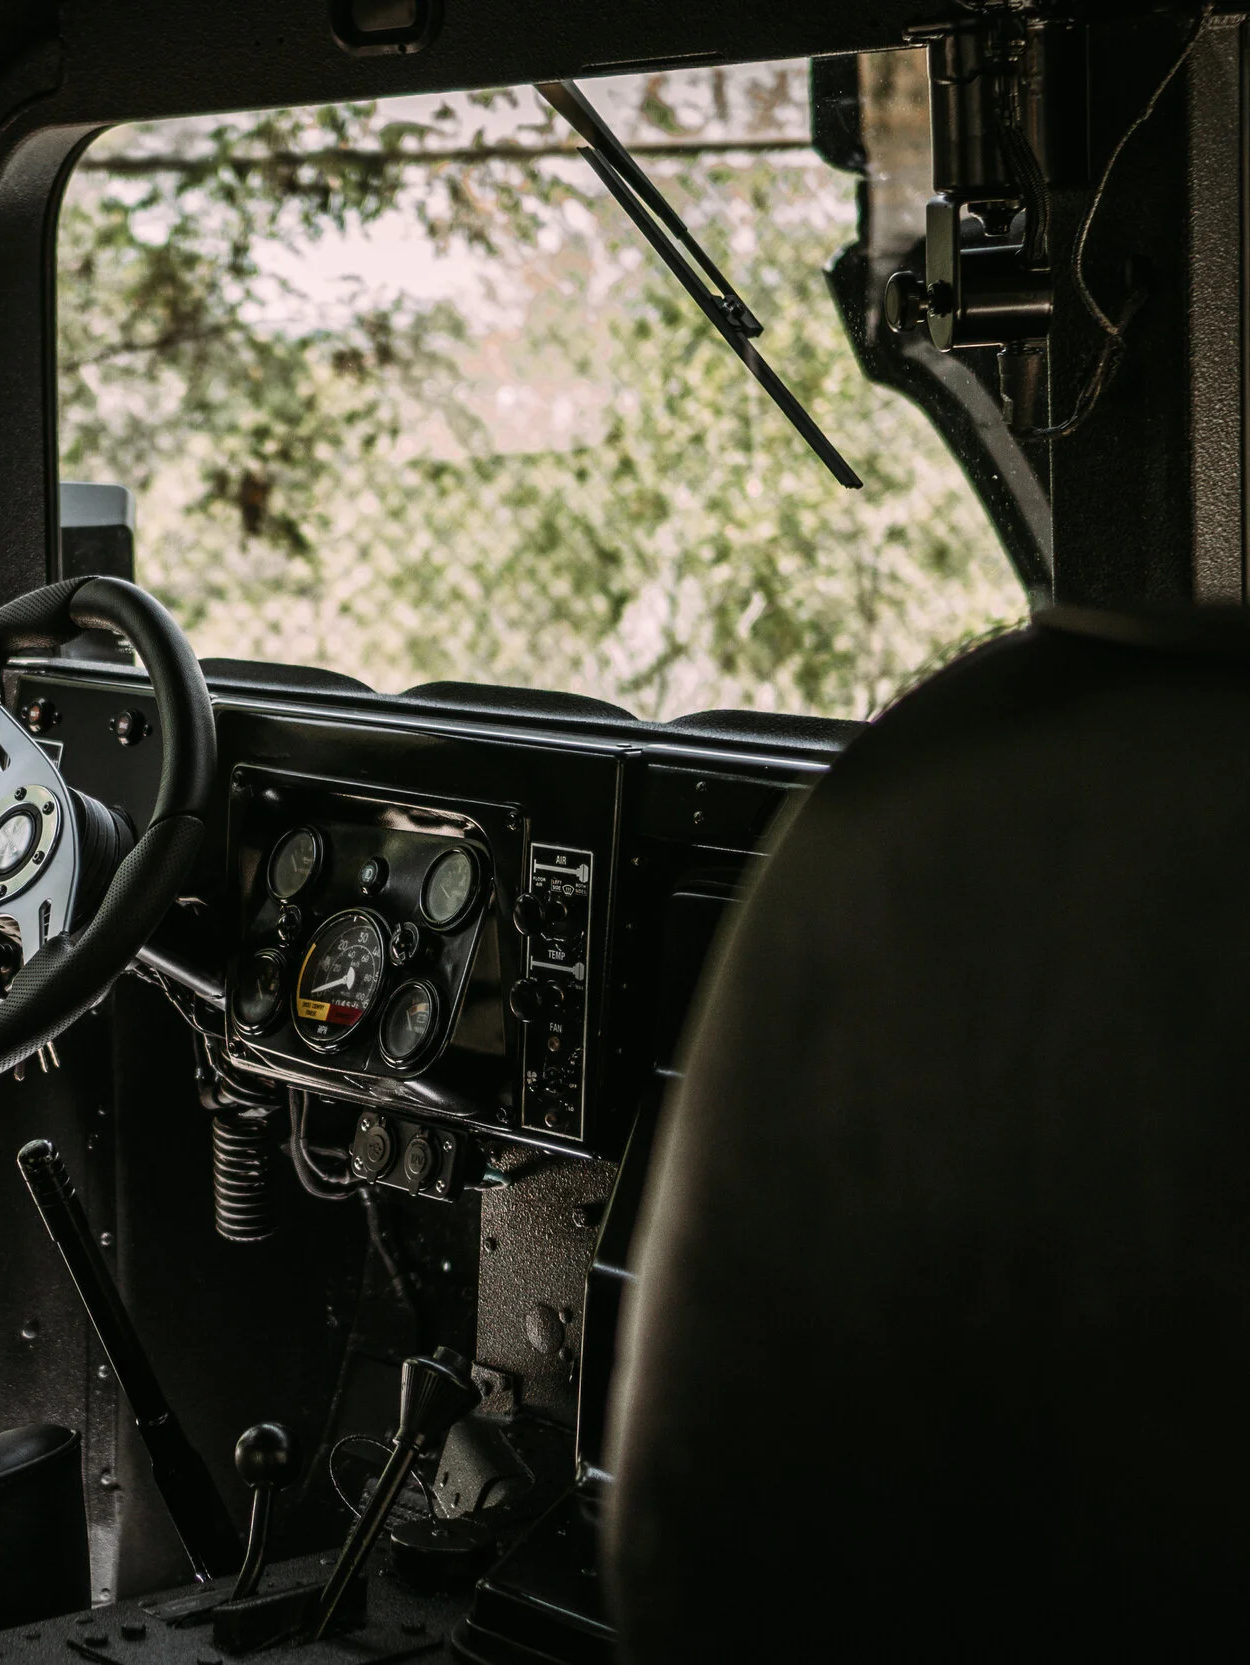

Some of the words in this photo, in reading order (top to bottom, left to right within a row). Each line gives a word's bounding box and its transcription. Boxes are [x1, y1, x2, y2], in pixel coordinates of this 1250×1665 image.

[556, 855, 566, 865] AIR
[357, 932, 369, 944] 30
[338, 939, 349, 951] 20
[348, 951, 356, 959] 40
[361, 955, 370, 963] 60
[548, 950, 566, 961] TEMP
[333, 965, 342, 973] 20
[363, 974, 372, 982] 80
[356, 992, 366, 1001] 100
[550, 1022, 562, 1033] FAN
